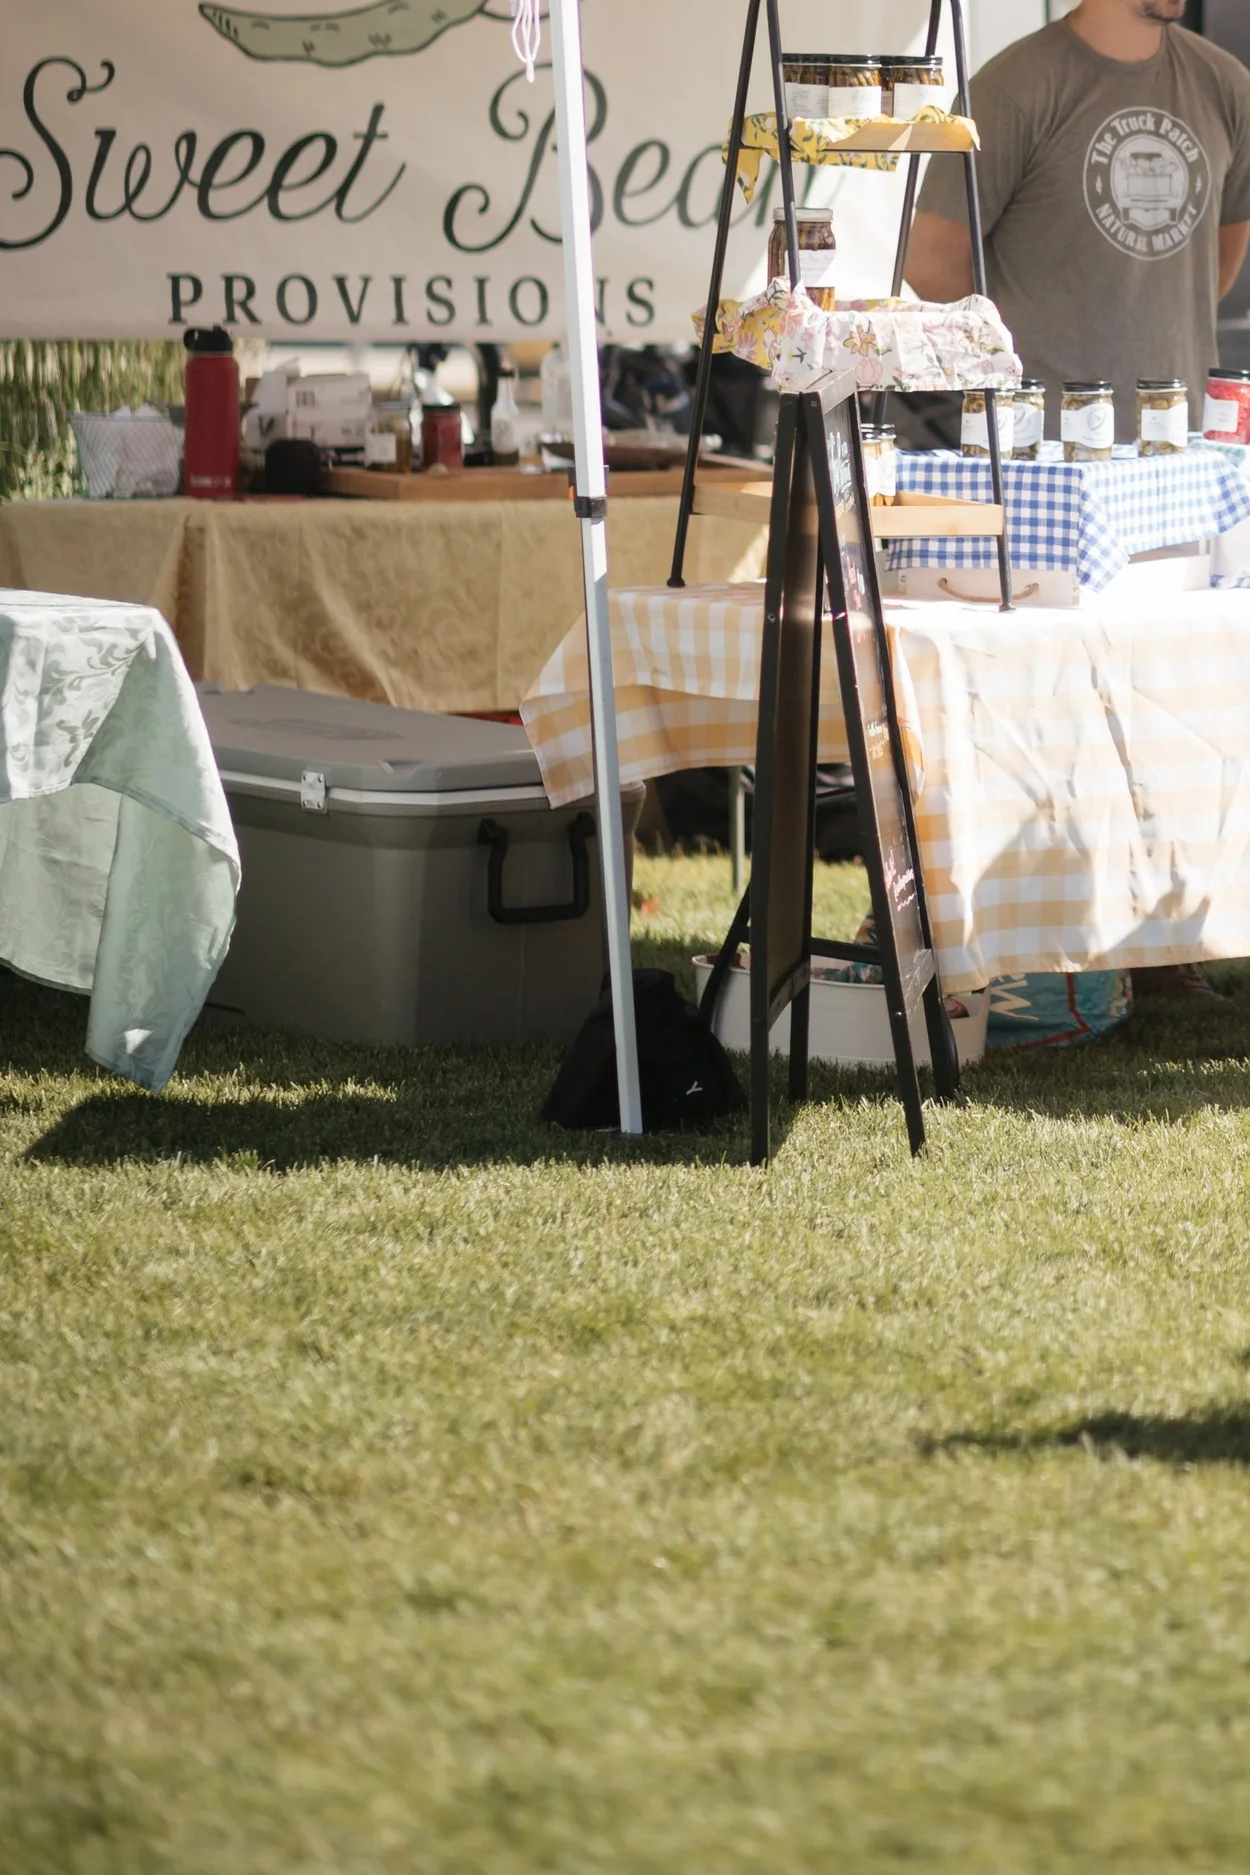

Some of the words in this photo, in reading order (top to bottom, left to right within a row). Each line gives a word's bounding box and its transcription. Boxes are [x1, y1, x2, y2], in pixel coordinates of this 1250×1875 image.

[0, 56, 407, 251] Sweet
[1091, 132, 1118, 165] The
[1110, 112, 1156, 136] Truck
[1158, 116, 1200, 163] Patch
[1095, 202, 1149, 253] NATURAL
